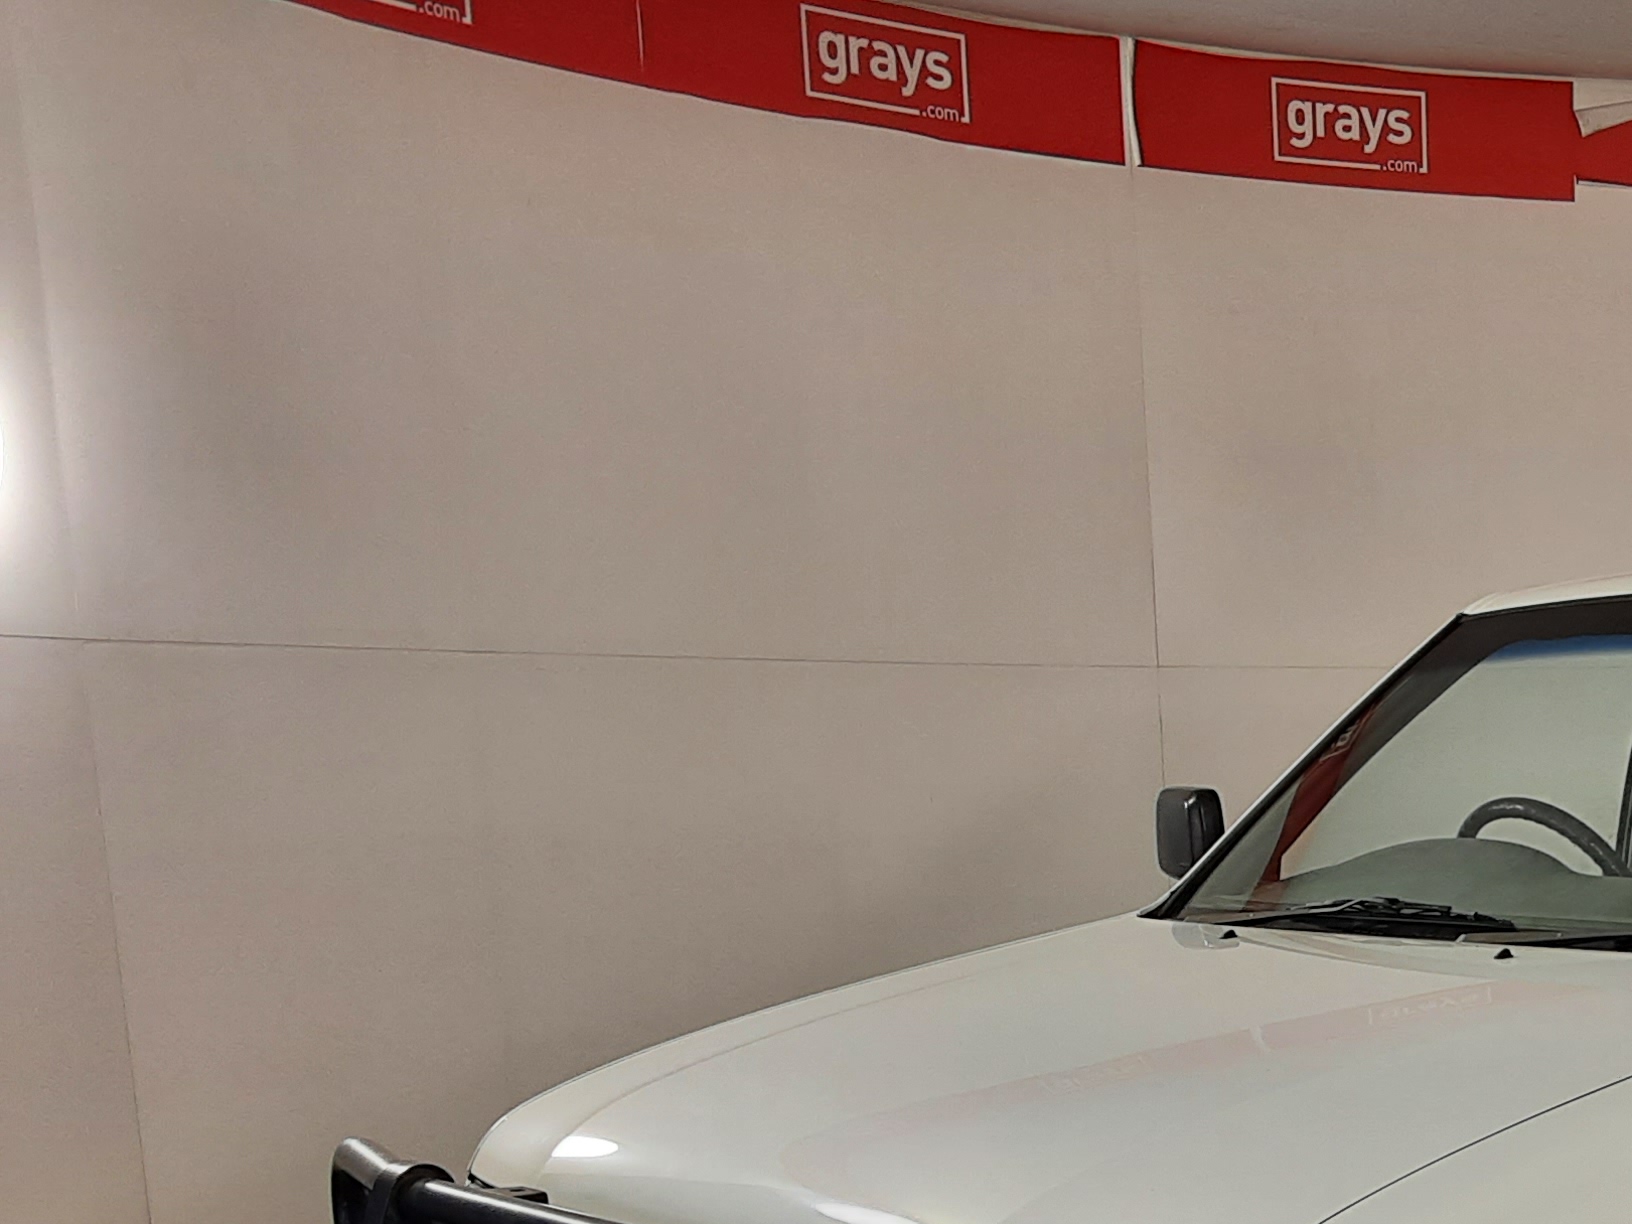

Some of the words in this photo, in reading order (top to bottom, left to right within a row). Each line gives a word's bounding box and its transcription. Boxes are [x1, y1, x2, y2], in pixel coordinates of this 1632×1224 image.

[418, 0, 461, 23] .com
[817, 29, 953, 98] grays
[921, 104, 960, 122] .com
[1286, 98, 1413, 154] grays
[1382, 159, 1418, 173] .com
